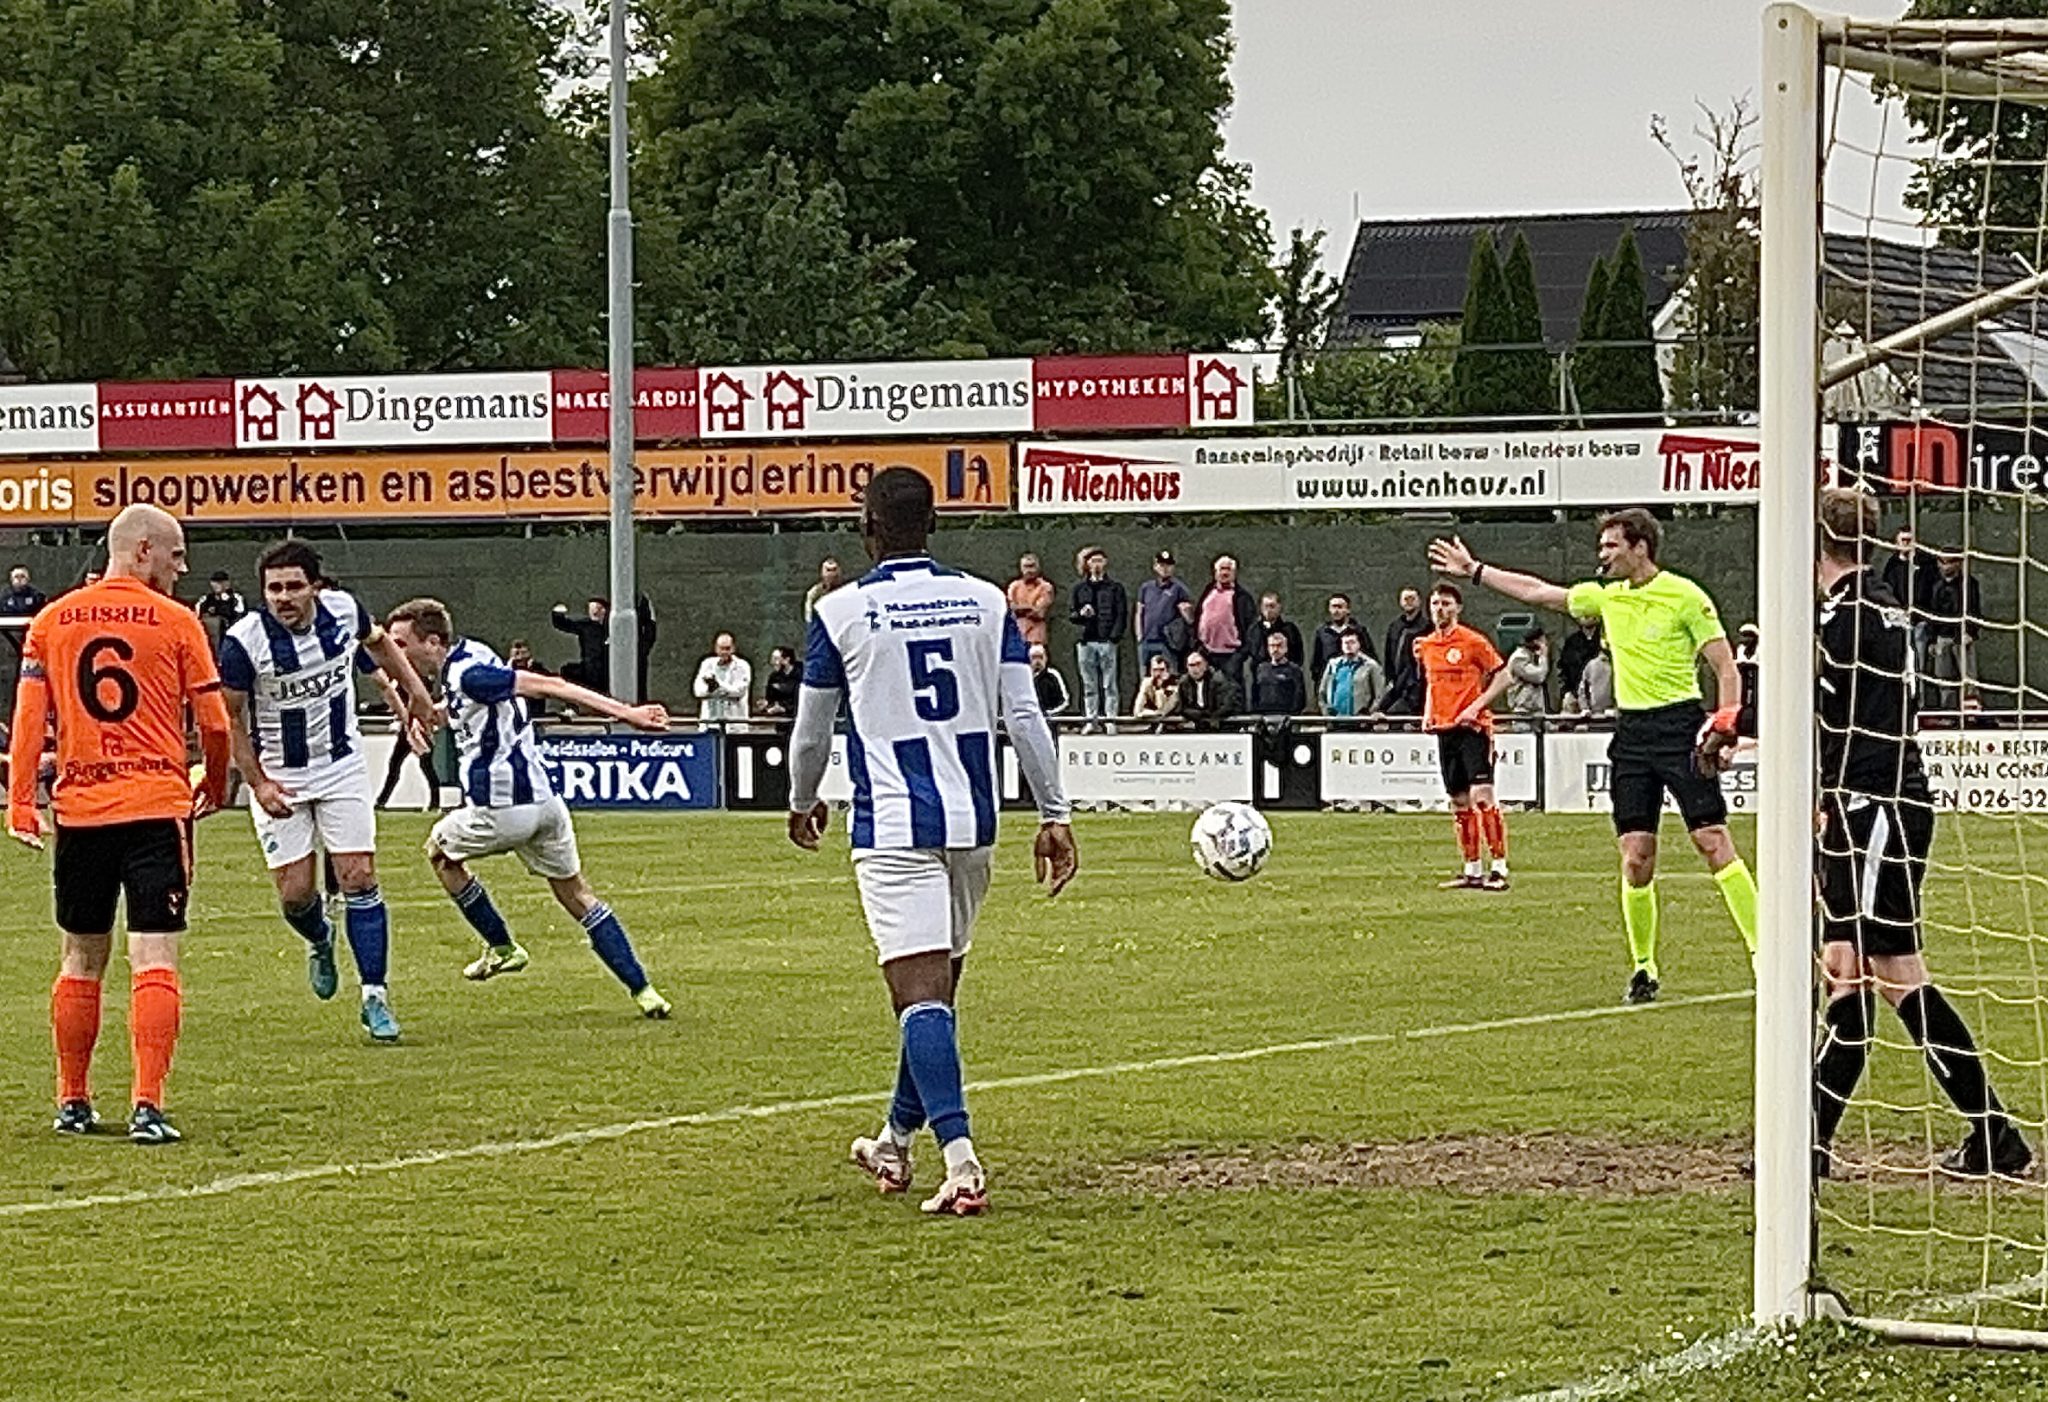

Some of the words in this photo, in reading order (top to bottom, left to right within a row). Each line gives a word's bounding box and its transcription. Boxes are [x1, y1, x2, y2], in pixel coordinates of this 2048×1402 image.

[555, 389, 696, 410] MAKEARDIJ
[815, 374, 1029, 421] Dingemans
[1036, 376, 1186, 398] HYPOTHEKEN
[344, 386, 549, 430] Dingemans
[93, 462, 364, 516] sloopwerken
[381, 469, 432, 503] en
[1061, 461, 1181, 503] Nienhaus
[1296, 468, 1545, 500] www.nienhaus.nl
[77, 636, 139, 723] 6
[905, 636, 960, 723] 5
[630, 740, 695, 757] Pedicure
[1068, 750, 1126, 766] REBO
[1139, 750, 1244, 766] RECLAME
[1330, 748, 1395, 765] REBO
[1951, 762, 1989, 779] VAN
